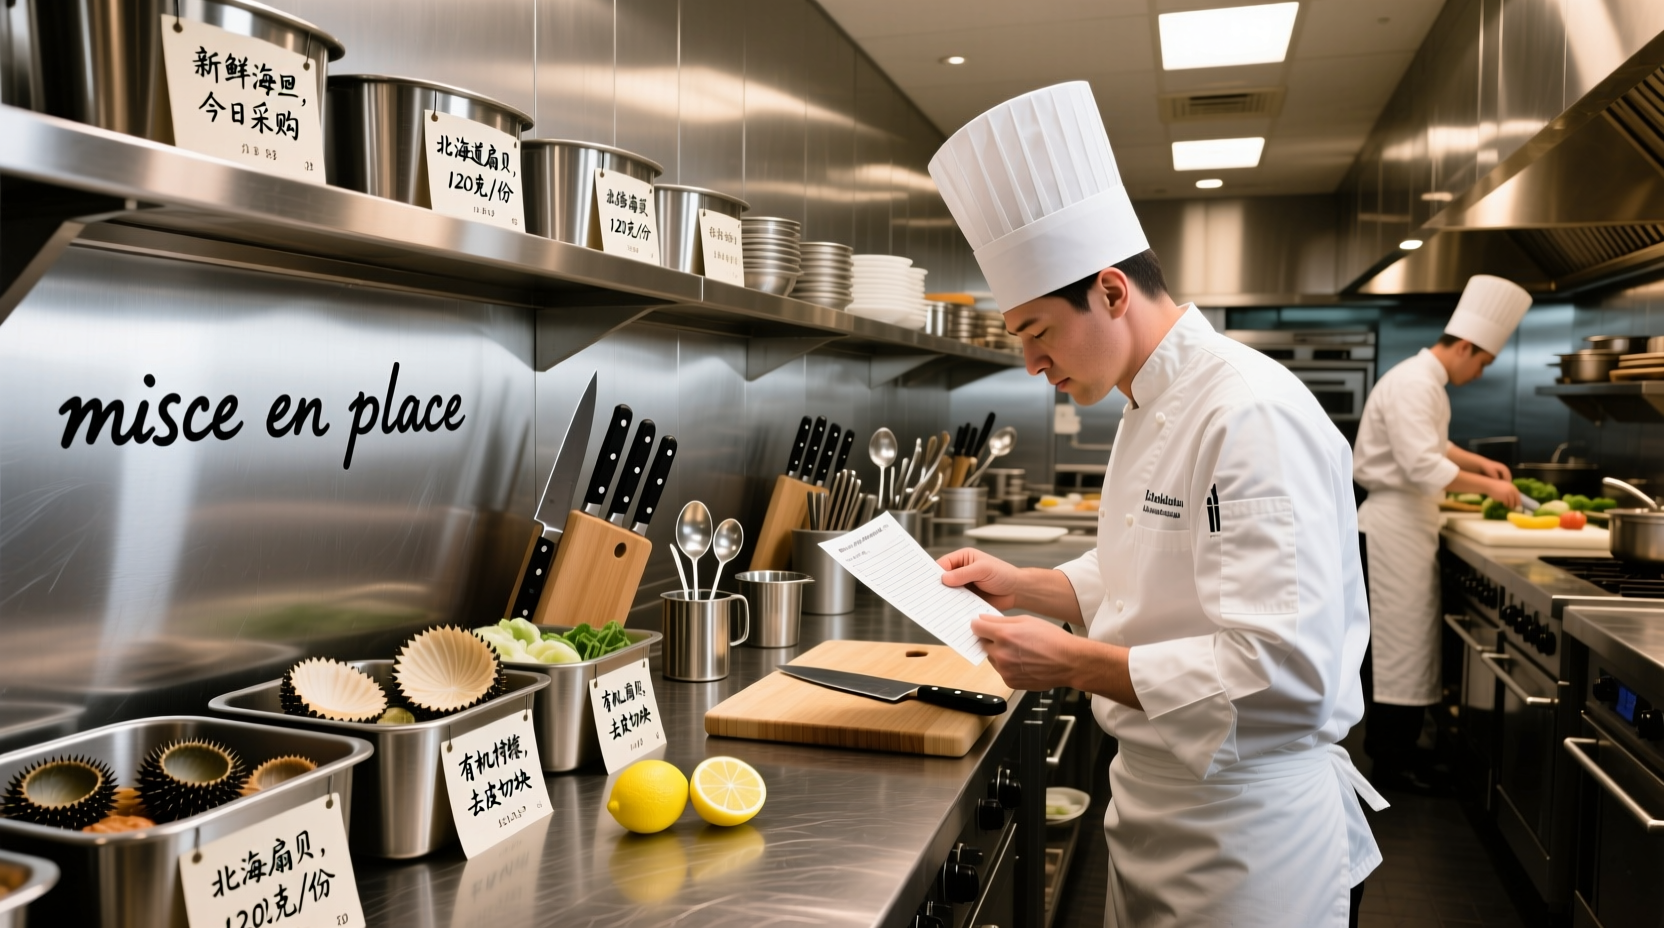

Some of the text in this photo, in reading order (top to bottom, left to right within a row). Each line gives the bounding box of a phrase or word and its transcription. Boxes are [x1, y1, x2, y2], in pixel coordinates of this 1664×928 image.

[198, 91, 299, 141] 今日采购
[448, 170, 514, 204] 120克/份
[58, 362, 466, 470] misce en place
[468, 768, 533, 817] 去皮切块
[211, 830, 326, 898] 北海扇贝，
